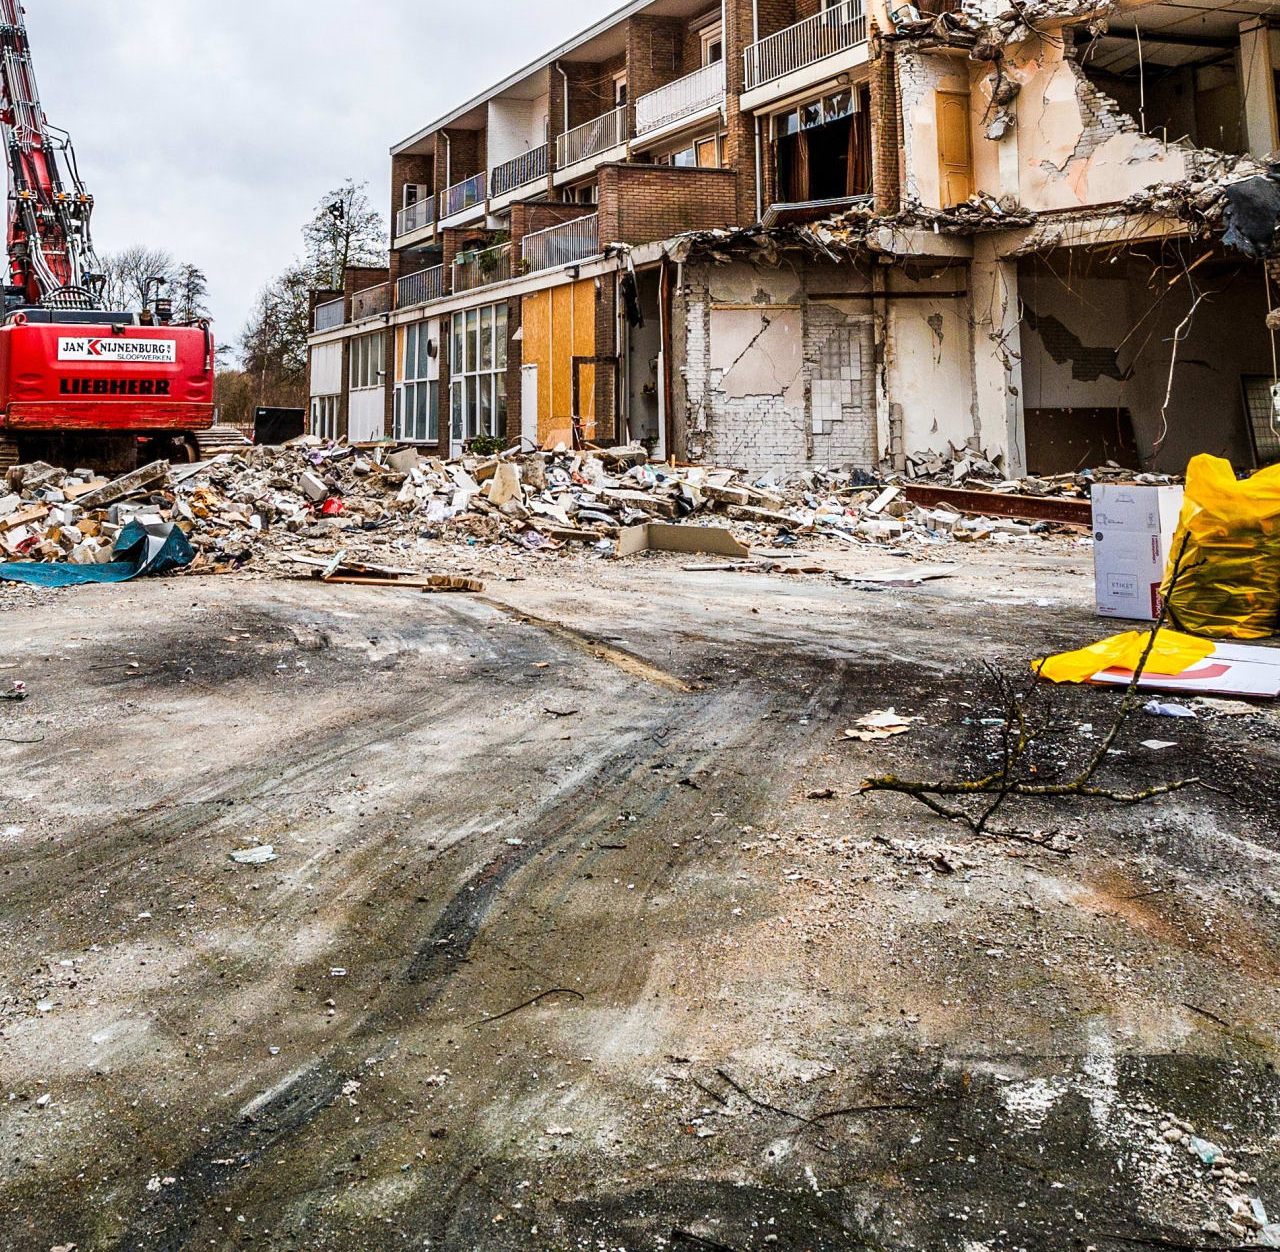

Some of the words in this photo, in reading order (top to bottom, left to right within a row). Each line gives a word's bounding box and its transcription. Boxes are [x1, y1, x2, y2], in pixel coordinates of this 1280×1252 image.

[63, 342, 84, 352] JAN
[87, 339, 166, 356] KNIJNENBURG
[116, 353, 172, 361] SLOOPWERKEN
[60, 378, 171, 395] LIEBHERR
